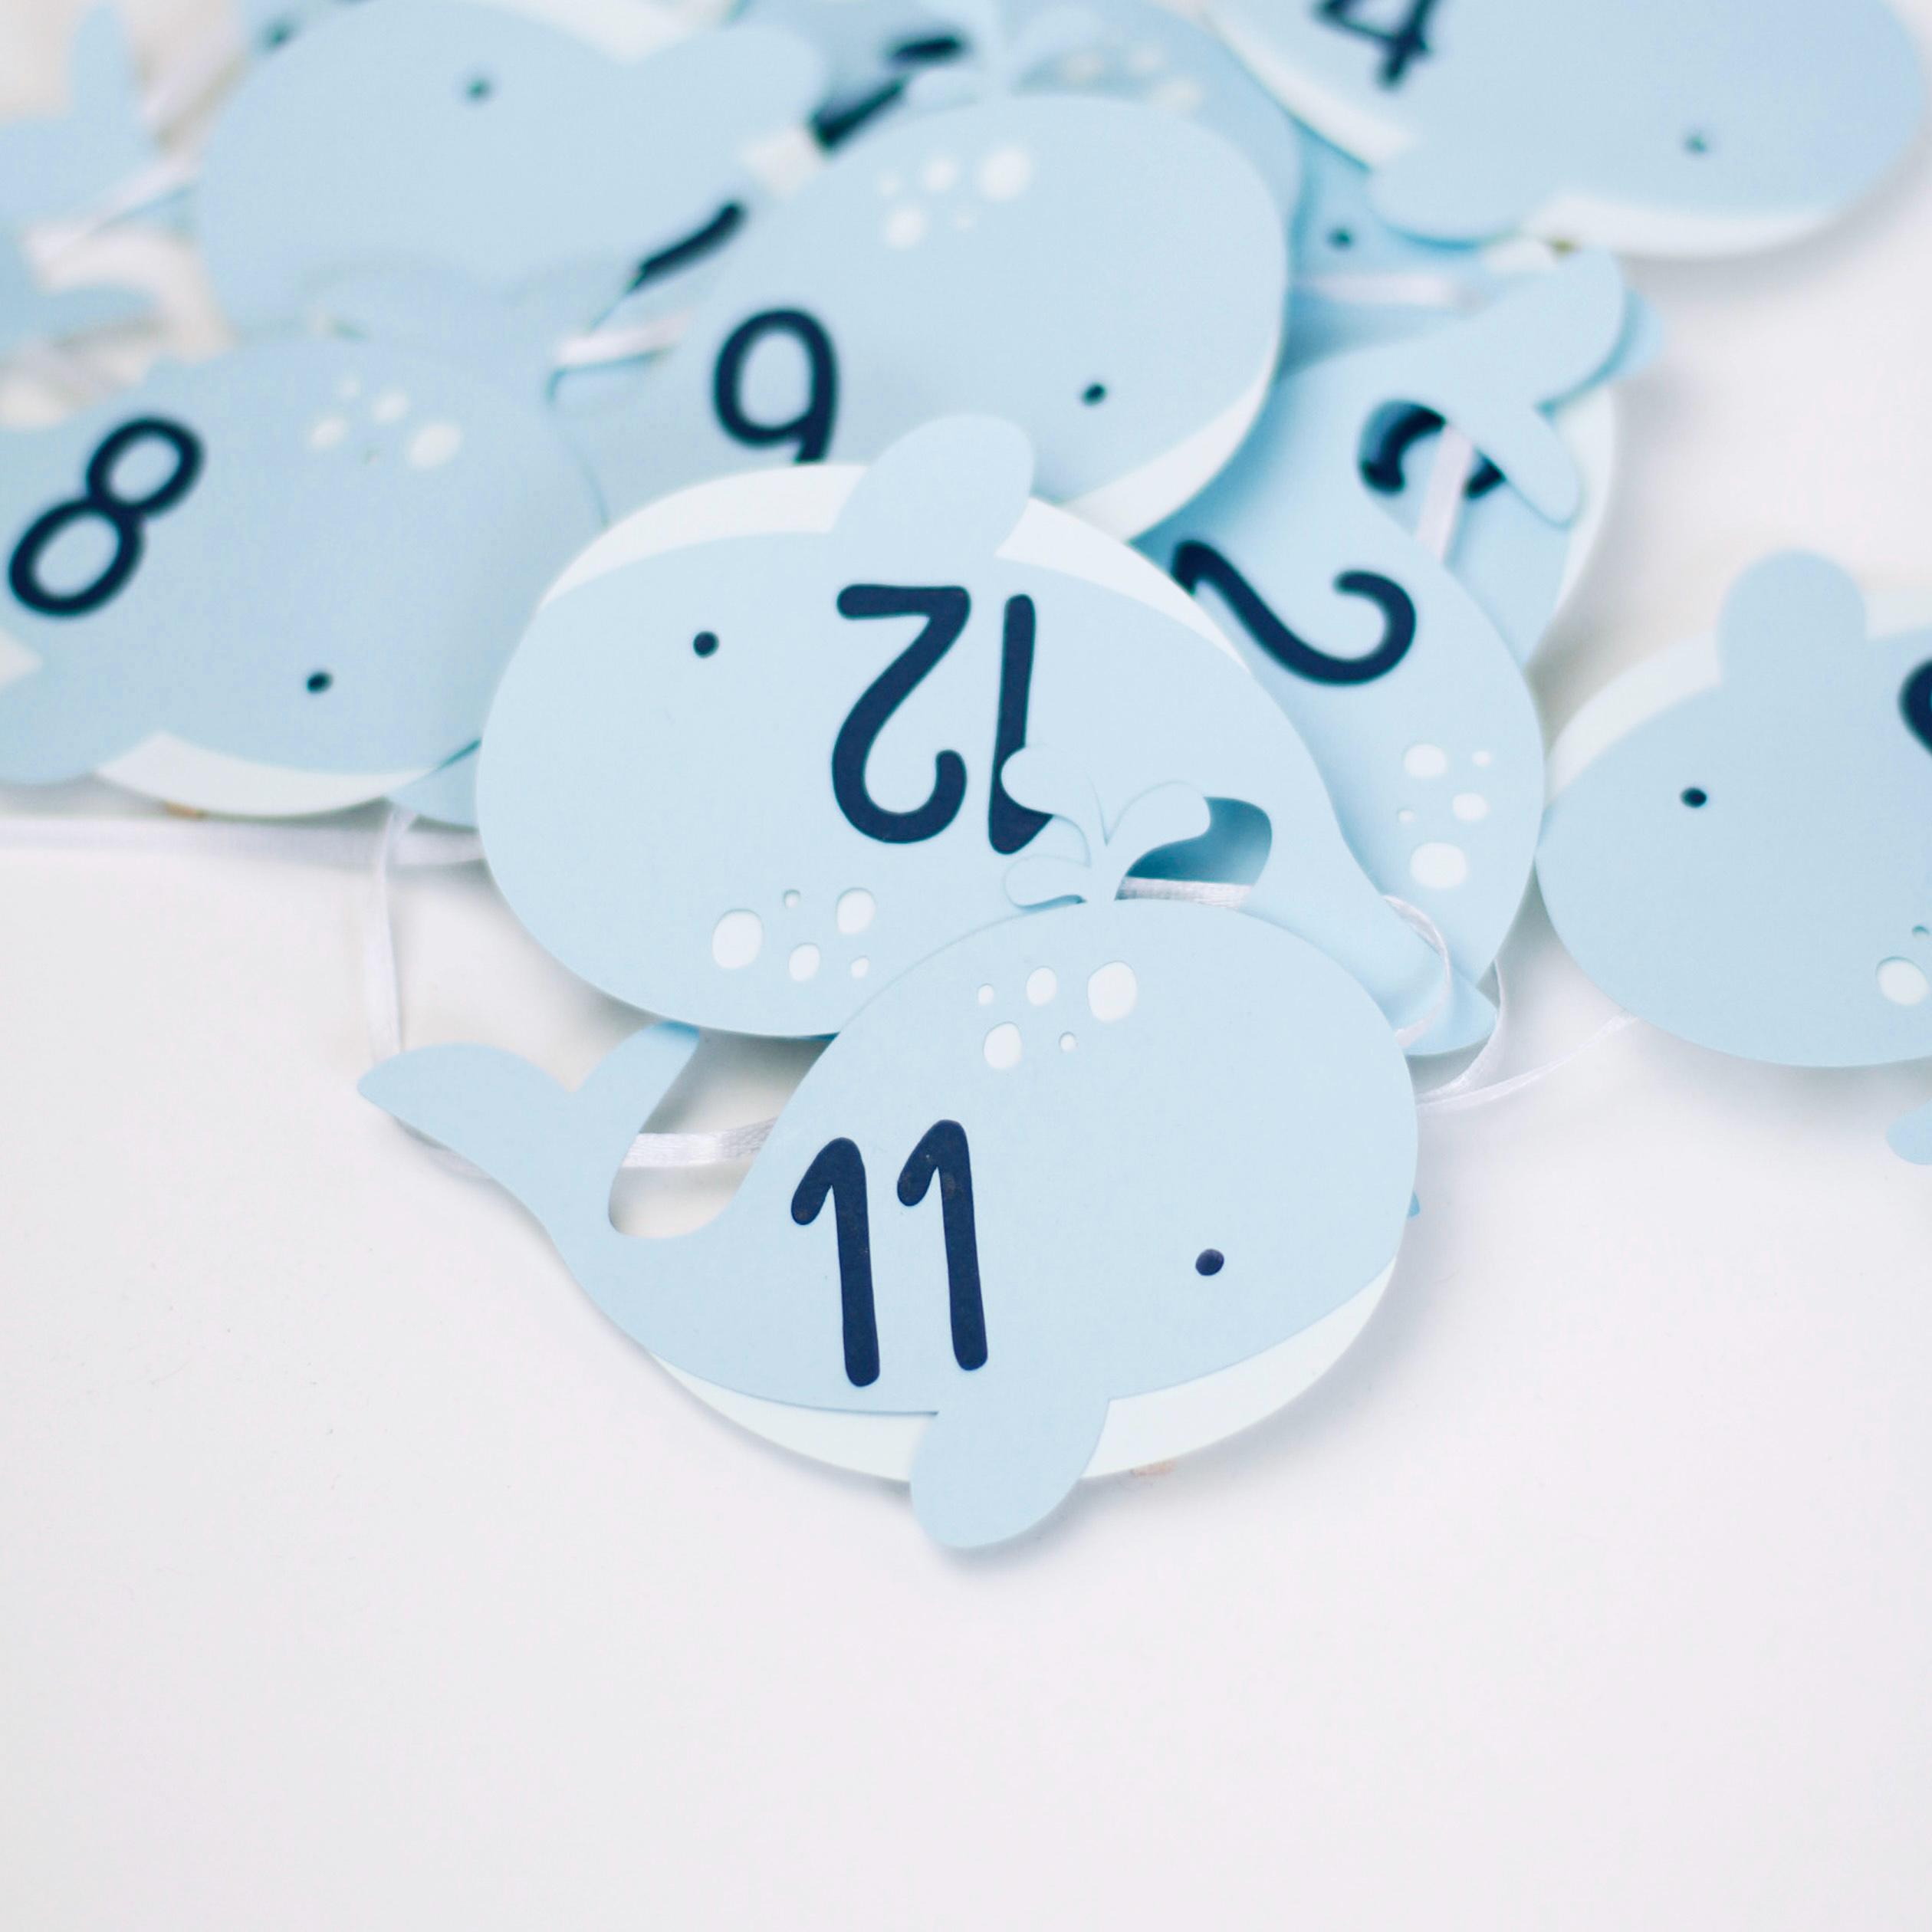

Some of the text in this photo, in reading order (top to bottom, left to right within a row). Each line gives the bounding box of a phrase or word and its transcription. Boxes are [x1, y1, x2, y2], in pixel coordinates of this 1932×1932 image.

[7, 415, 203, 618] 8
[1169, 537, 1417, 686] 2
[832, 583, 1053, 855] 12
[790, 1119, 988, 1387] 11
